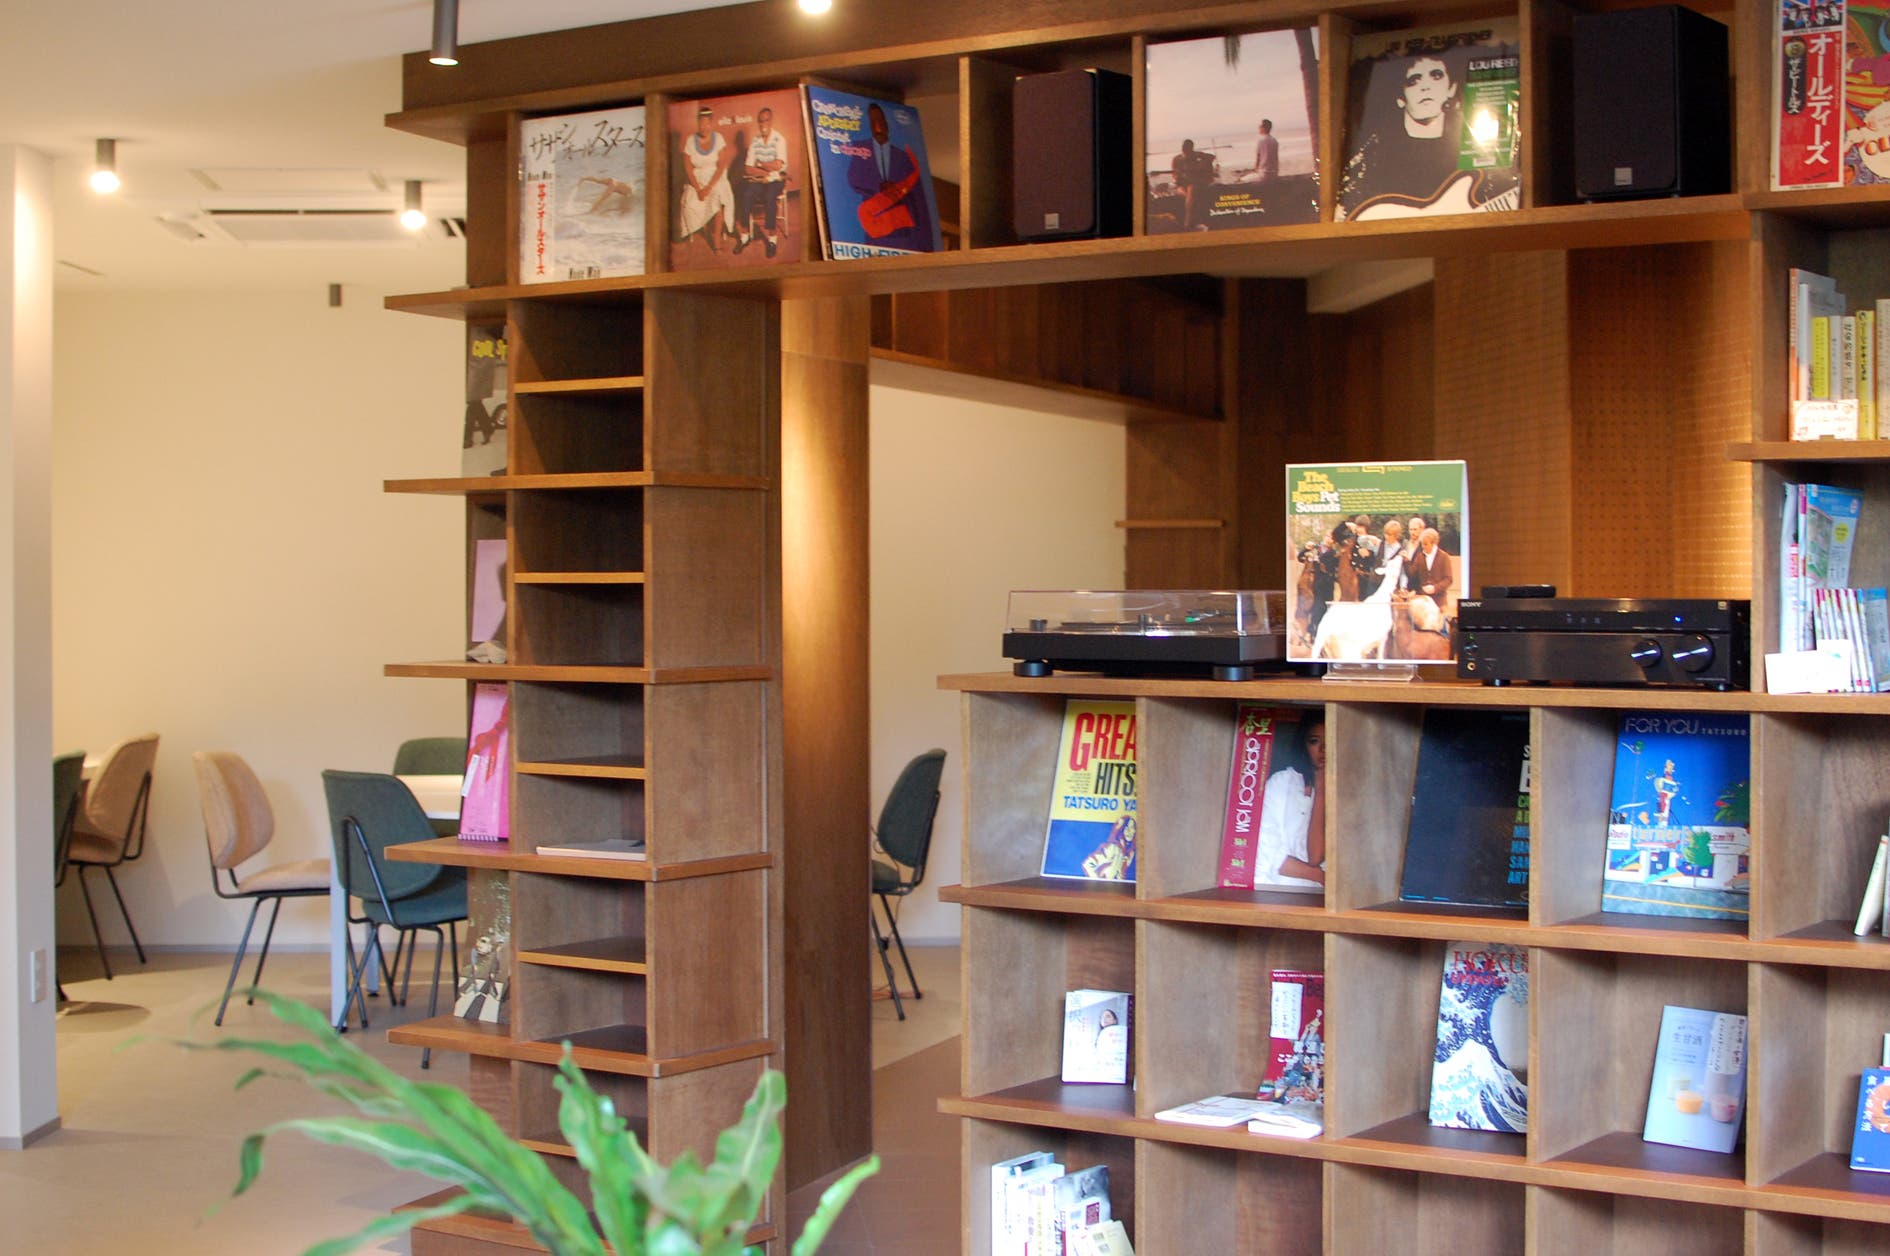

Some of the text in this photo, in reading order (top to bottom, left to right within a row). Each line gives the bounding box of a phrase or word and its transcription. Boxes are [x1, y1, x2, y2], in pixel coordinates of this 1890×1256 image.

[1805, 33, 1834, 164] オールディーズ
[1303, 471, 1328, 483] The
[1297, 481, 1335, 493] Beach
[1319, 490, 1340, 502] Pet
[1295, 501, 1342, 514] Sounds
[1624, 718, 1661, 734] FOR
[1664, 718, 1700, 735] YOU
[1063, 795, 1119, 811] TATSURO
